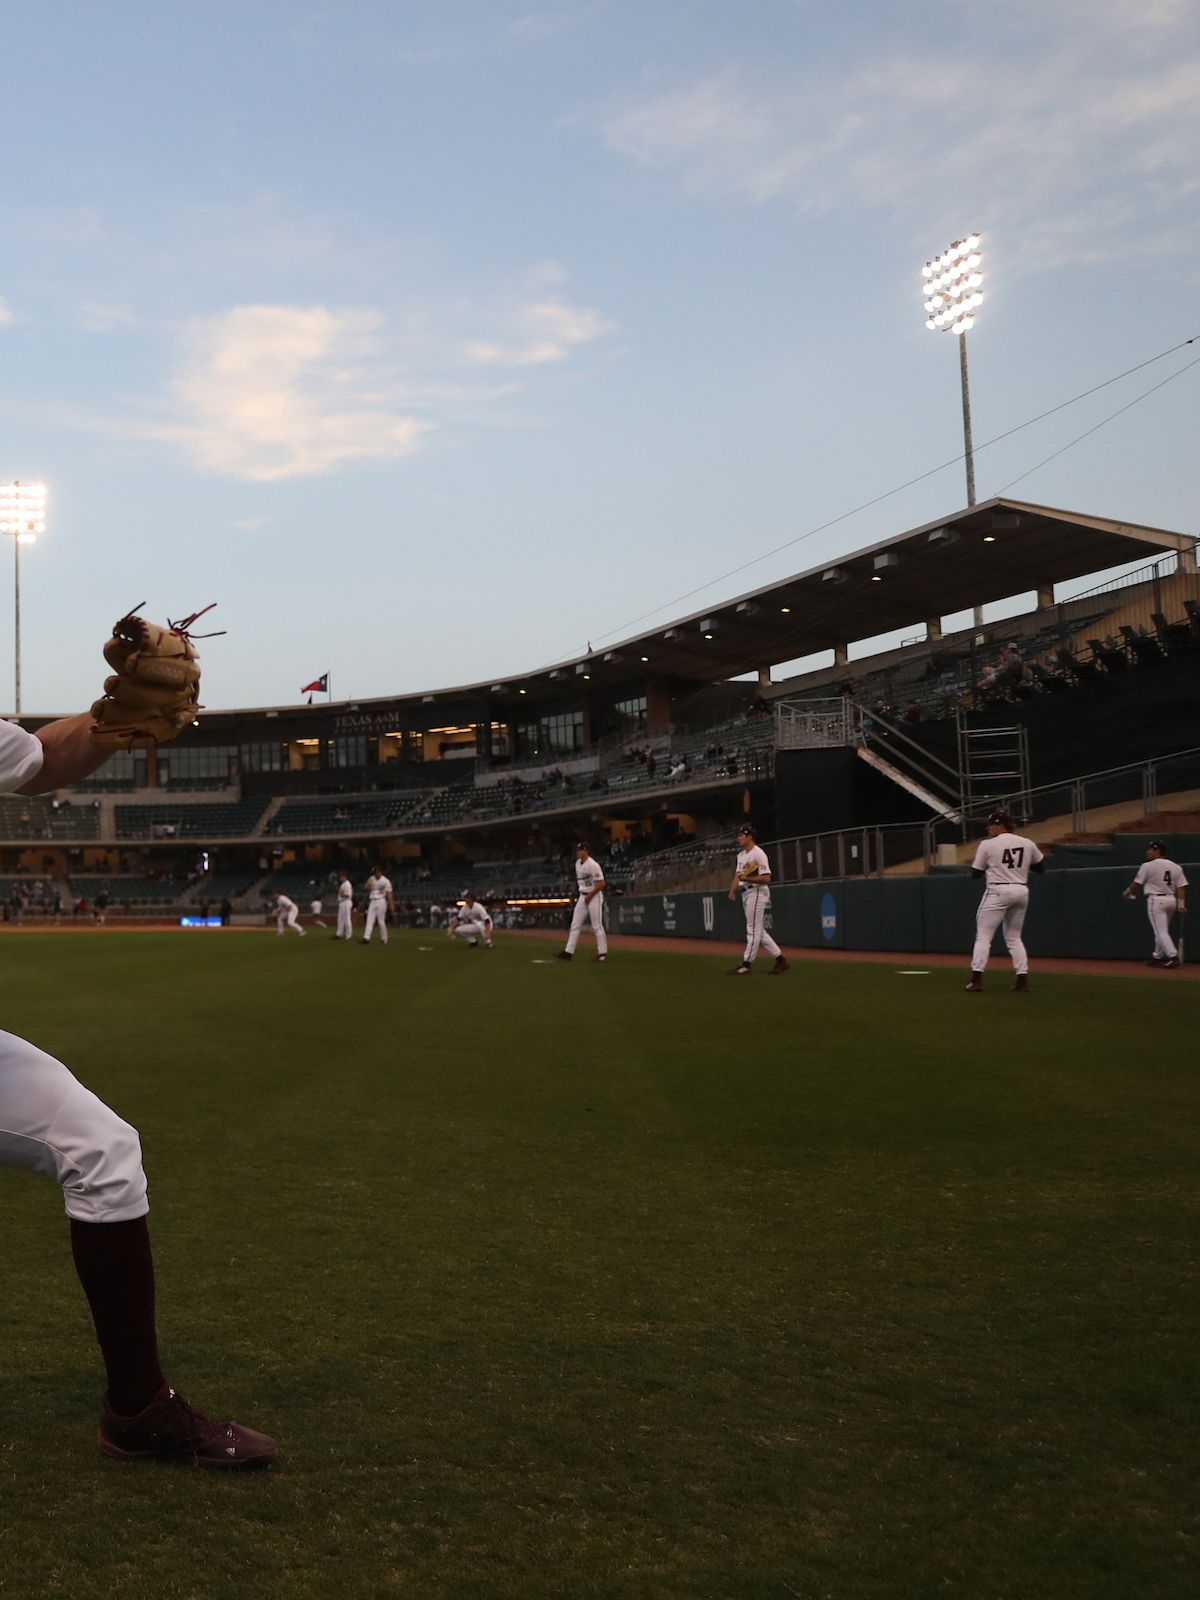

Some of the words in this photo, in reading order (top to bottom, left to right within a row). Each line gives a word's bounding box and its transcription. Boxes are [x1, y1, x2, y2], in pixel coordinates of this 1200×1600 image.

[334, 714, 372, 727] TEXAS
[1002, 847, 1024, 869] 47
[1163, 870, 1172, 887] 4
